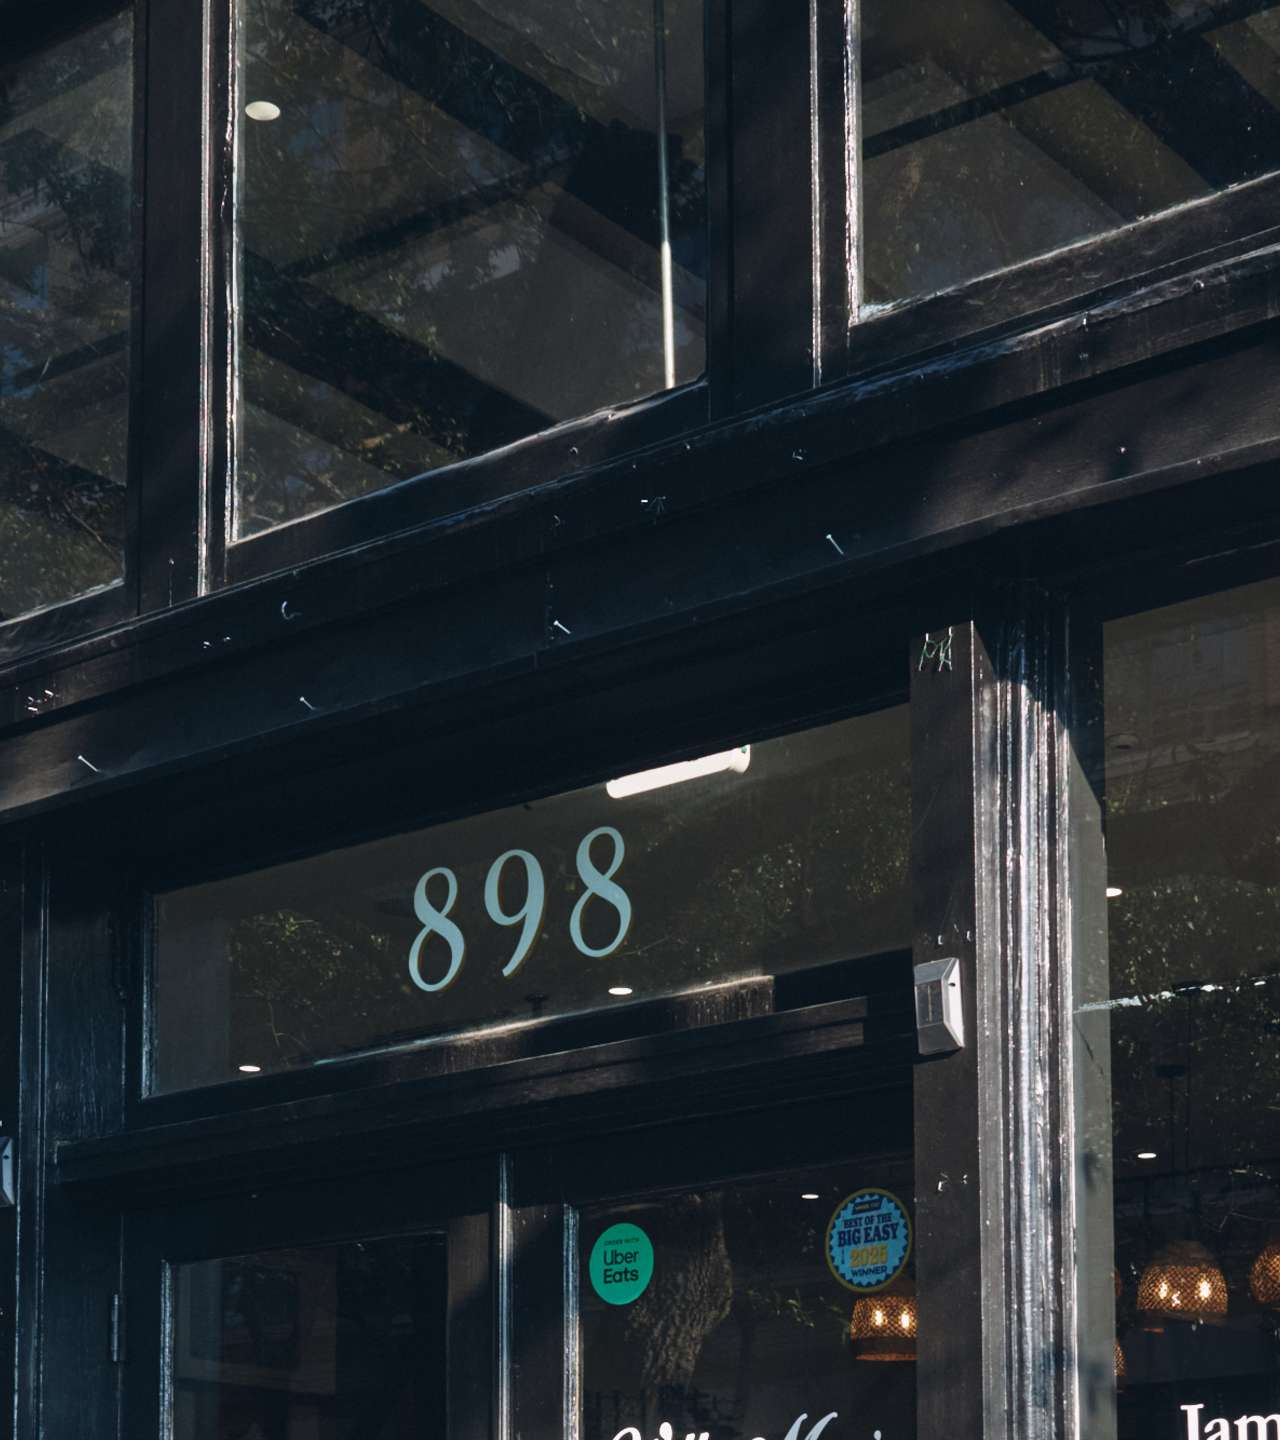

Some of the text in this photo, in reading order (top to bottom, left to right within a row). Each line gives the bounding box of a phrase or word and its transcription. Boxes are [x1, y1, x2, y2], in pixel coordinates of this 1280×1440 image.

[408, 826, 632, 992] 898
[843, 1213, 892, 1228] BEST OF THE
[837, 1222, 899, 1247] BIG EASY
[603, 1249, 640, 1266] Uber
[603, 1267, 640, 1284] Eats
[851, 1265, 888, 1277] WINNER
